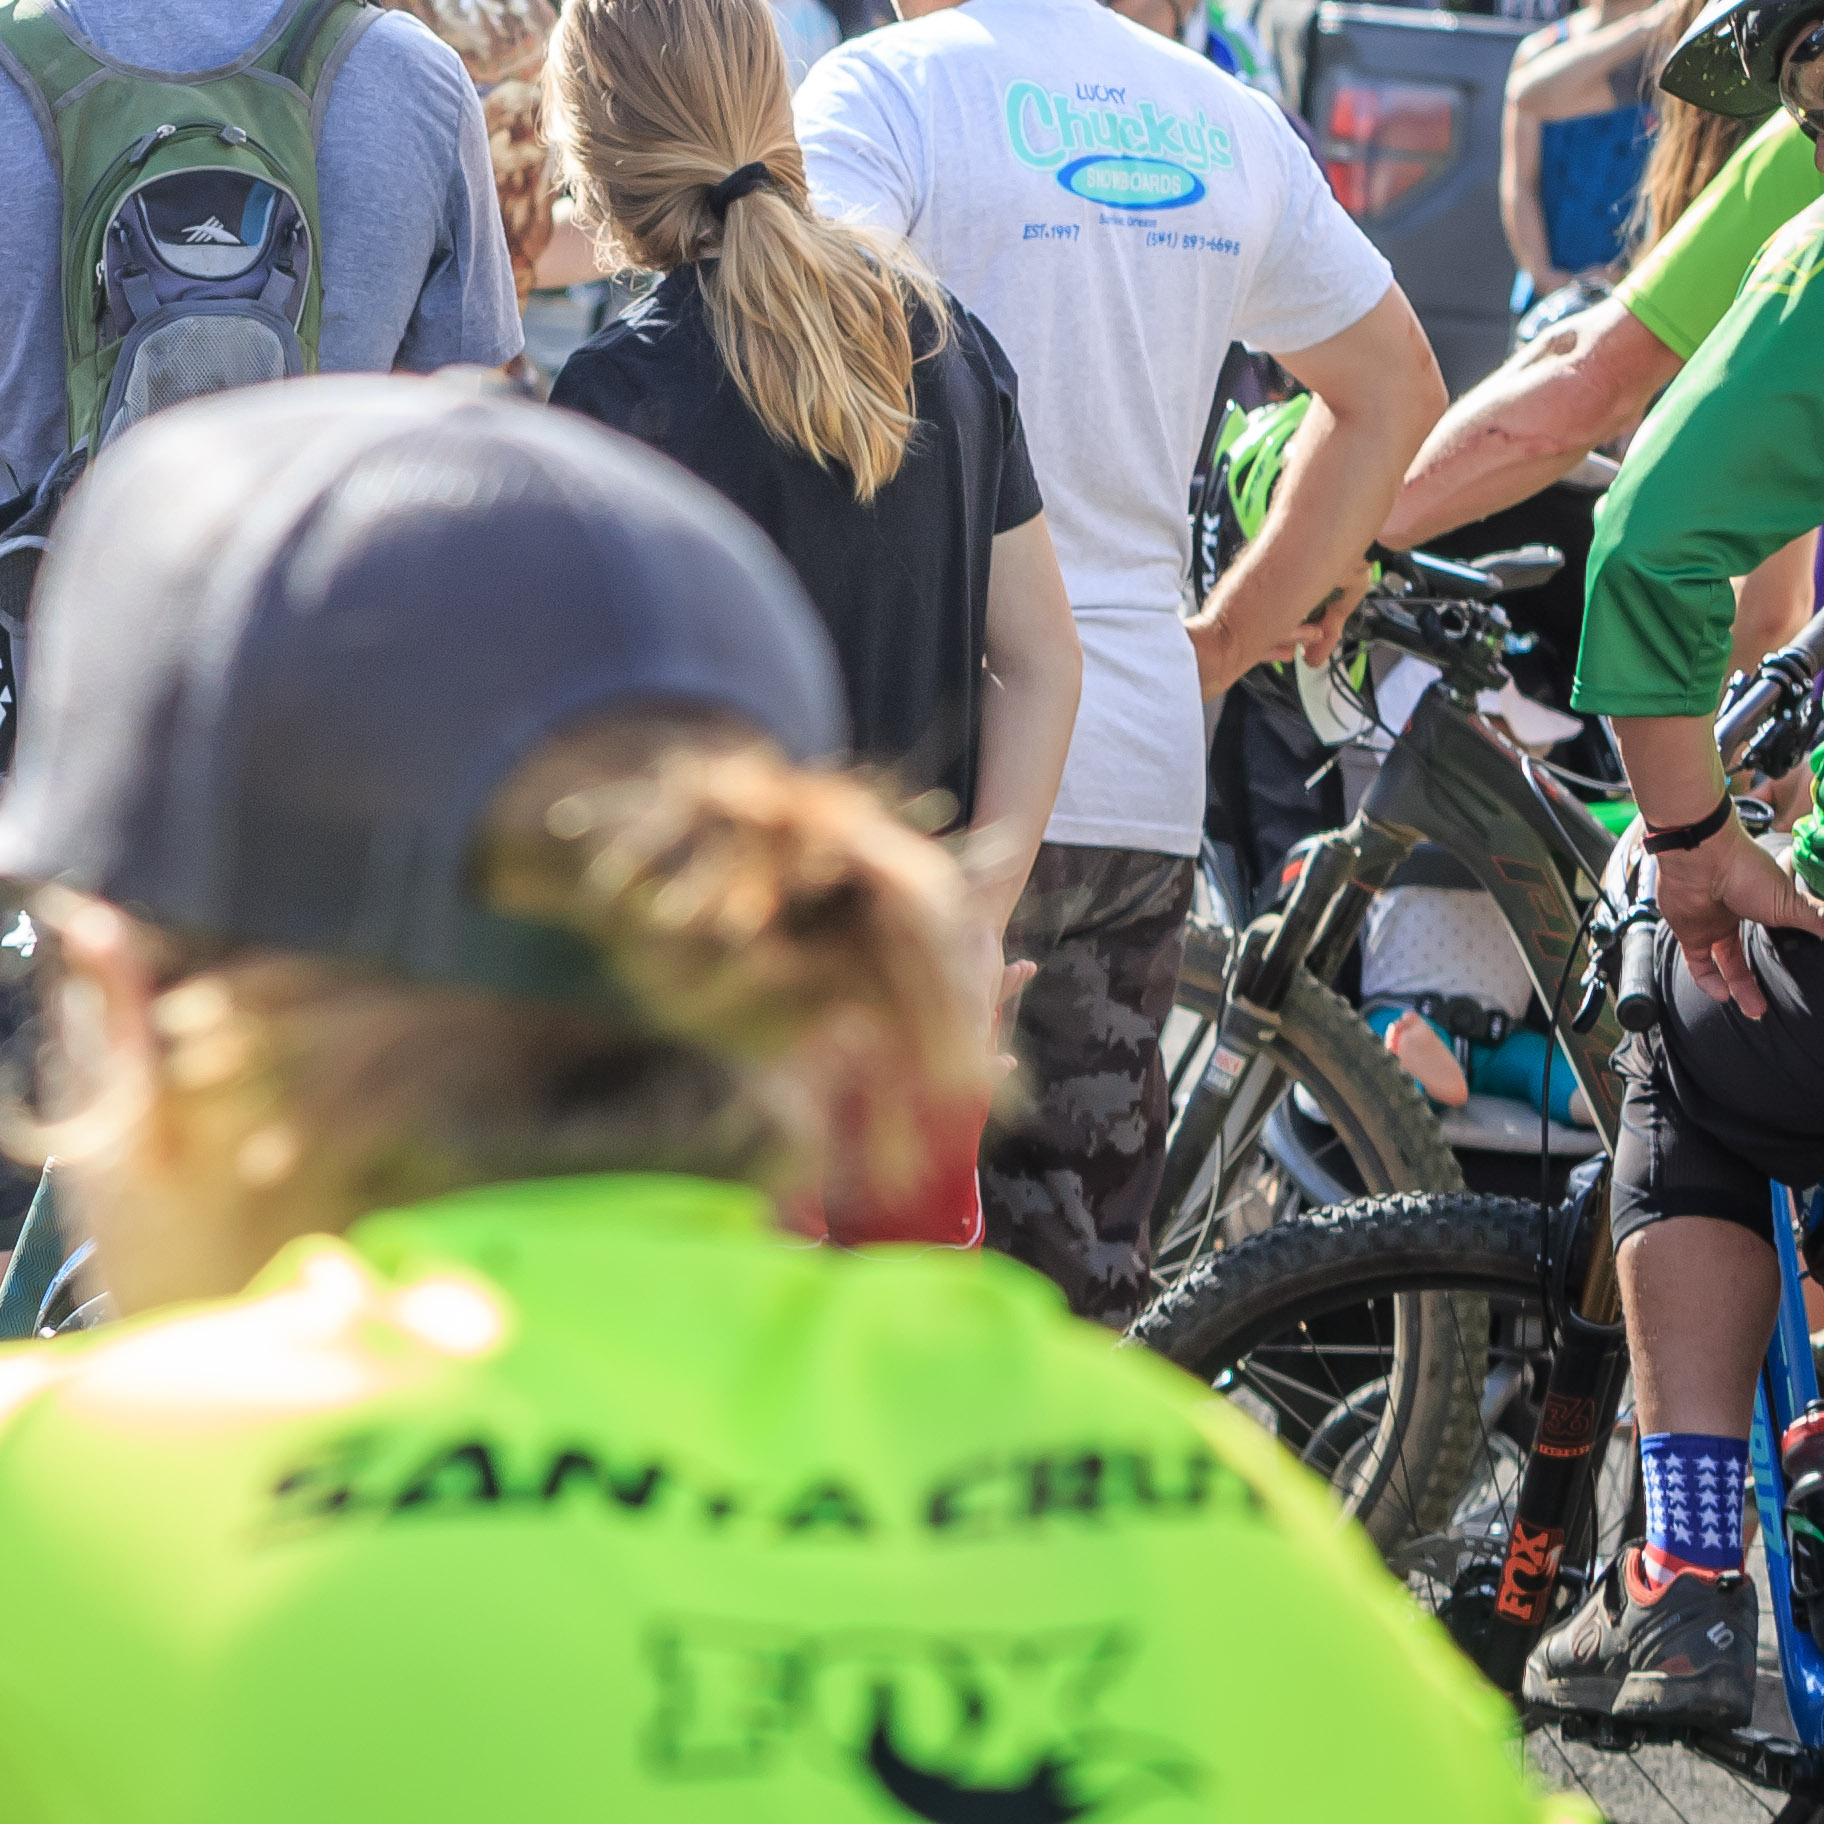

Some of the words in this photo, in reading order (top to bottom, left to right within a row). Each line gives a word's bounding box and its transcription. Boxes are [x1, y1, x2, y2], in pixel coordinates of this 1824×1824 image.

[1004, 78, 1236, 175] Chucky's
[1085, 167, 1184, 196] SNOWBOARDS
[1496, 1520, 1551, 1621] FOX
